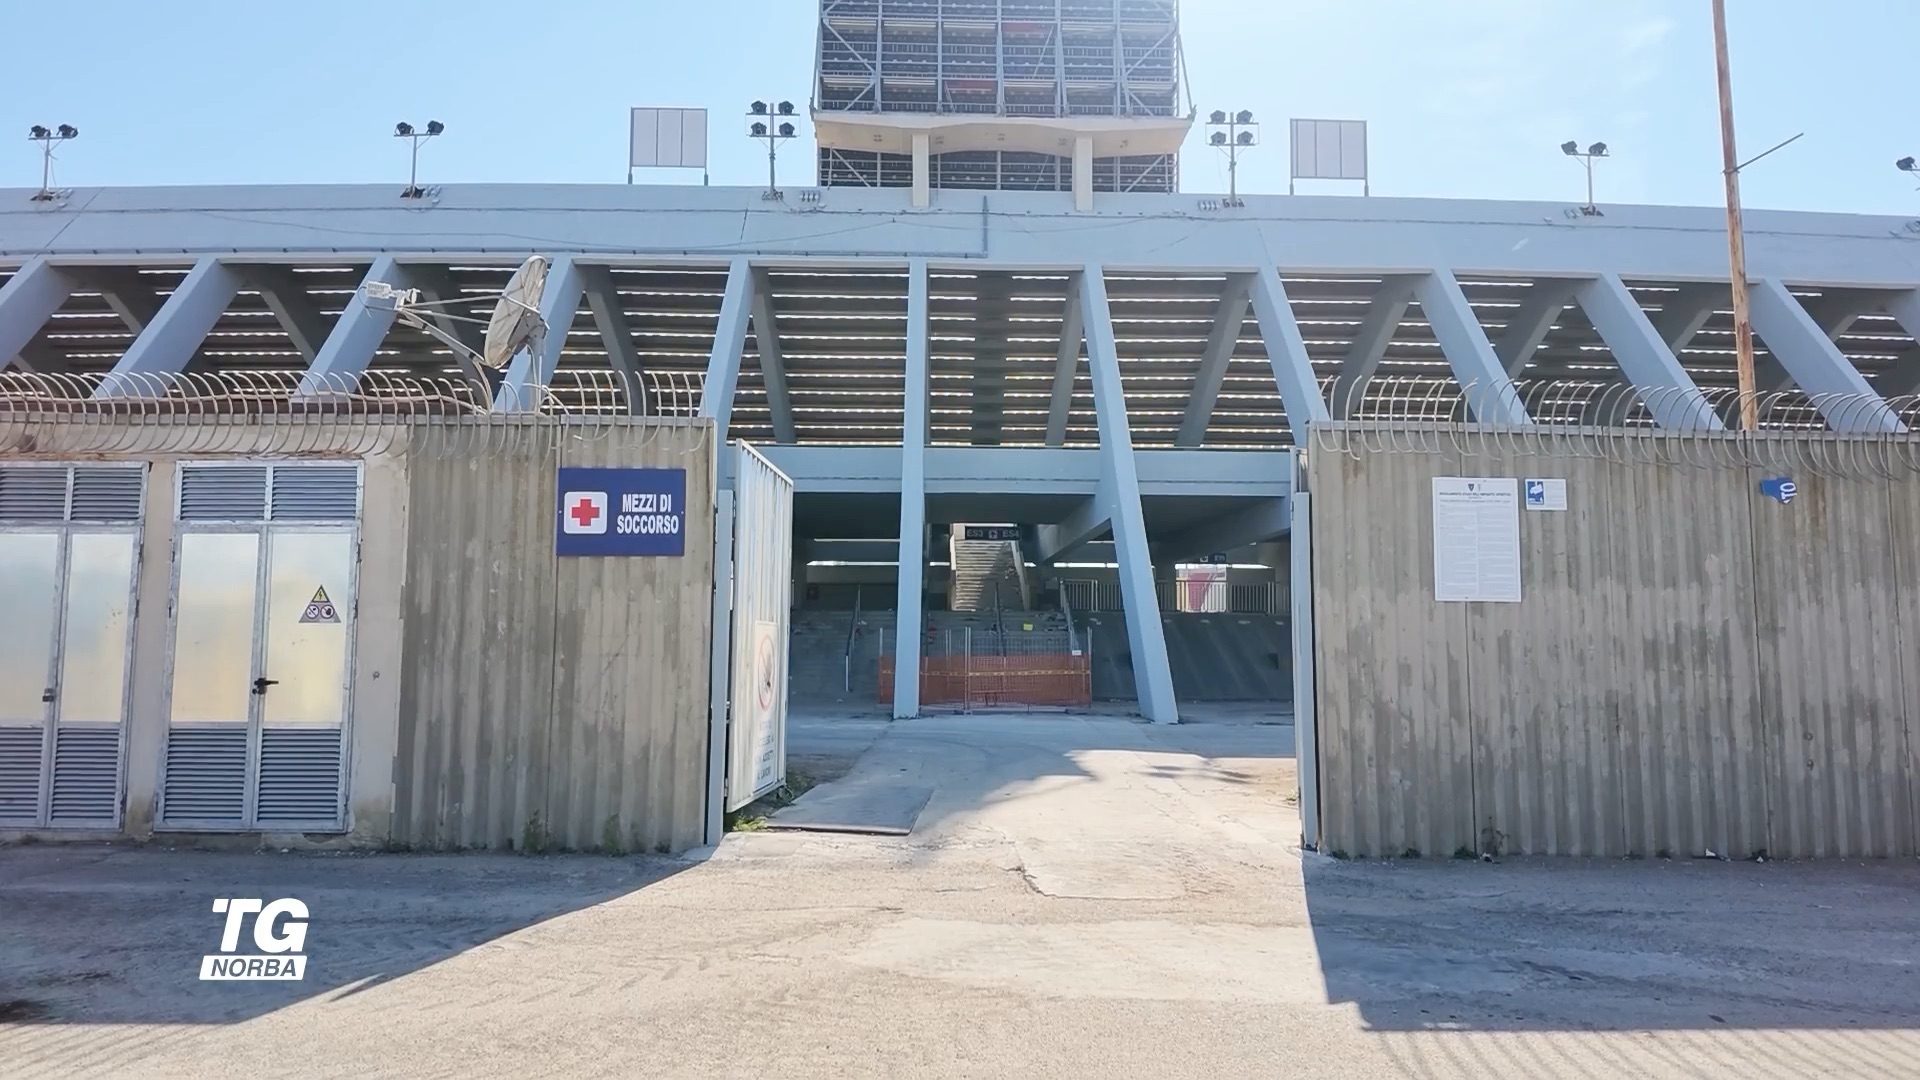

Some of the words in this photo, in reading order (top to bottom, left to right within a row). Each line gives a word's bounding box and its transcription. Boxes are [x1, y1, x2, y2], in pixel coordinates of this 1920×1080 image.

[622, 493, 657, 513] MEZZI
[660, 493, 672, 513] DI
[616, 515, 680, 534] SOCCORSO
